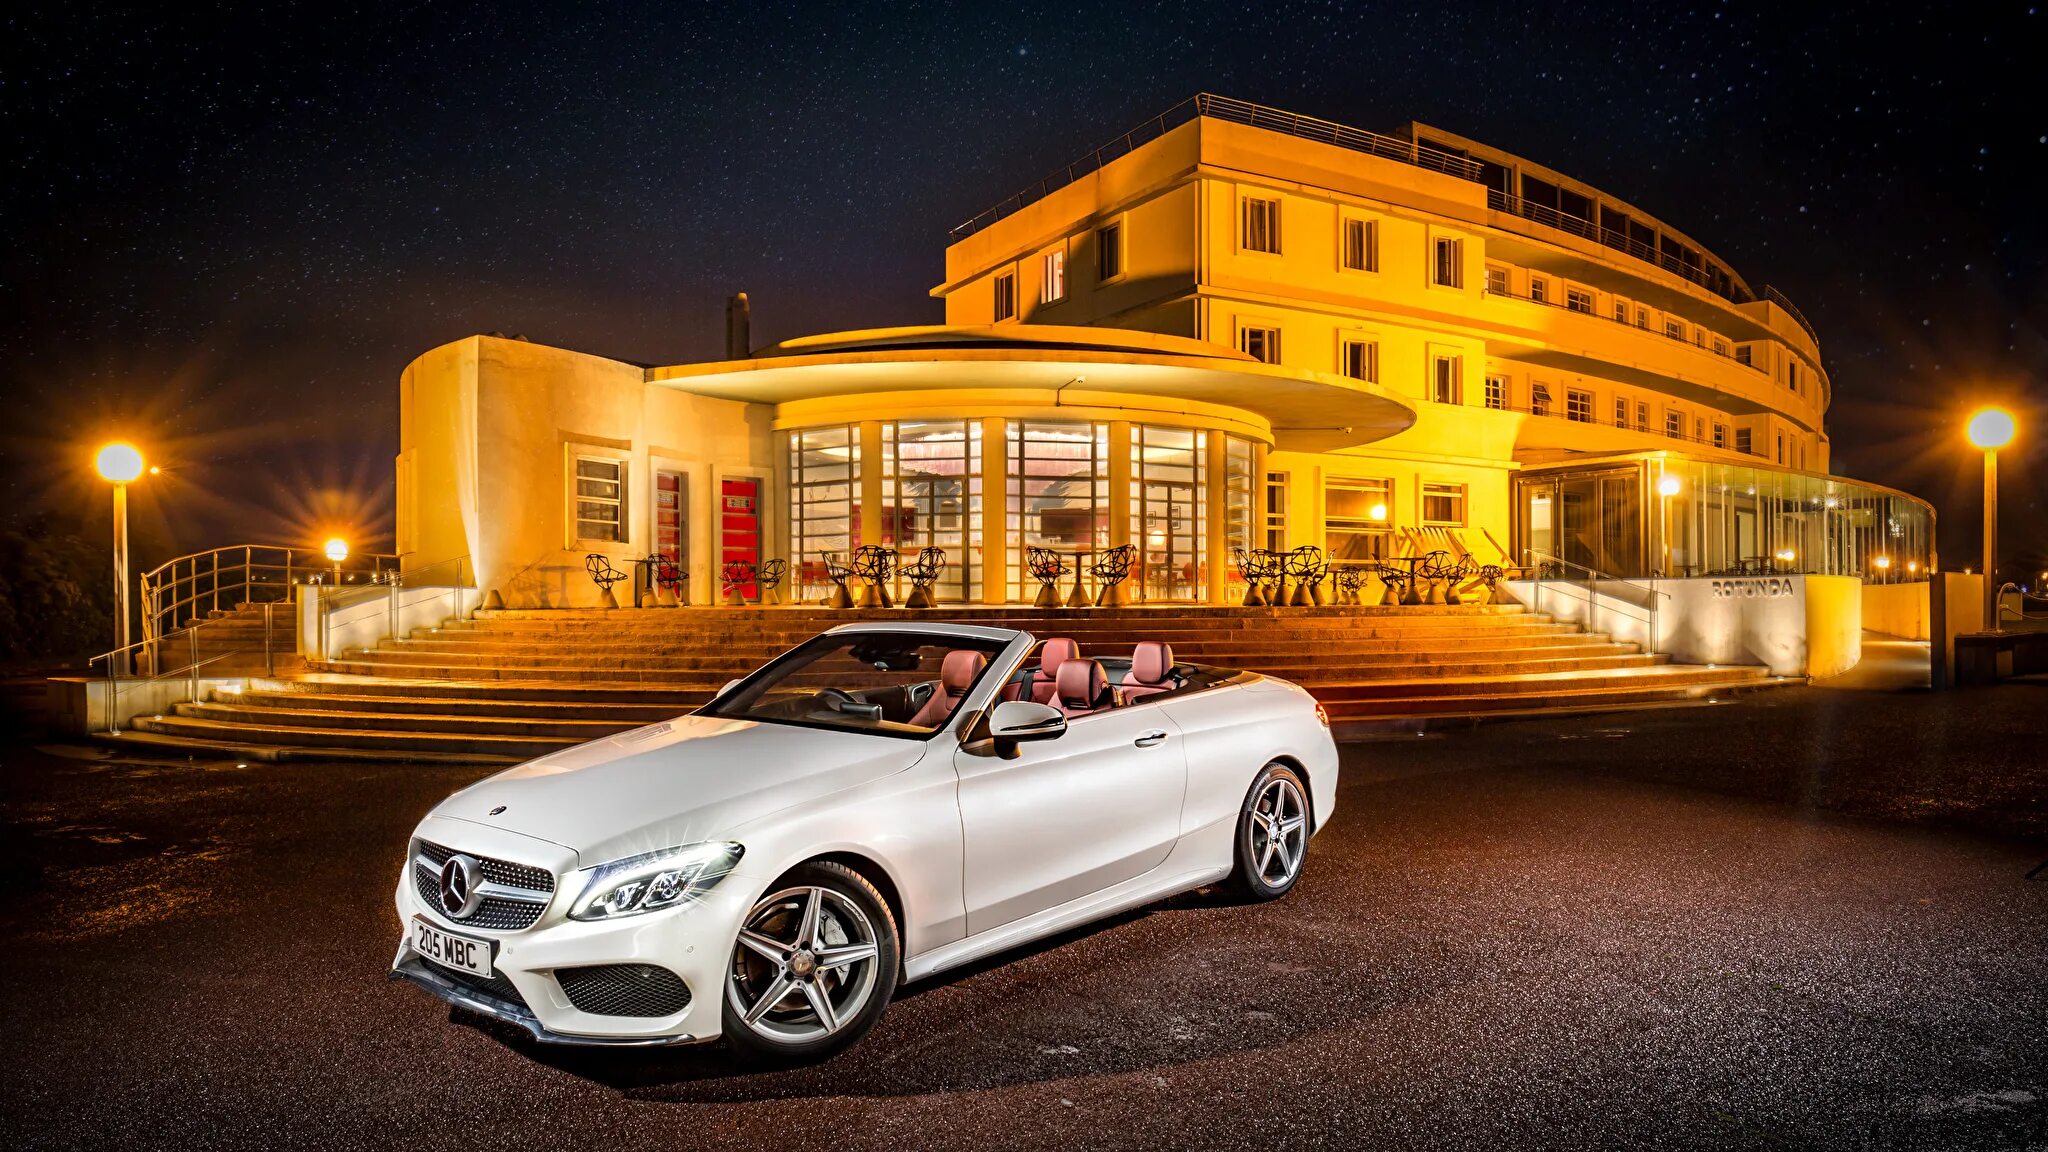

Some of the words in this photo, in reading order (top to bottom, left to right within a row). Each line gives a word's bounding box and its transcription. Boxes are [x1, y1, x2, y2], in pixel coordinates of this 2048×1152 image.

[1712, 578, 1794, 599] ROTUNDA
[418, 925, 441, 958] 205
[443, 936, 477, 969] MBC
